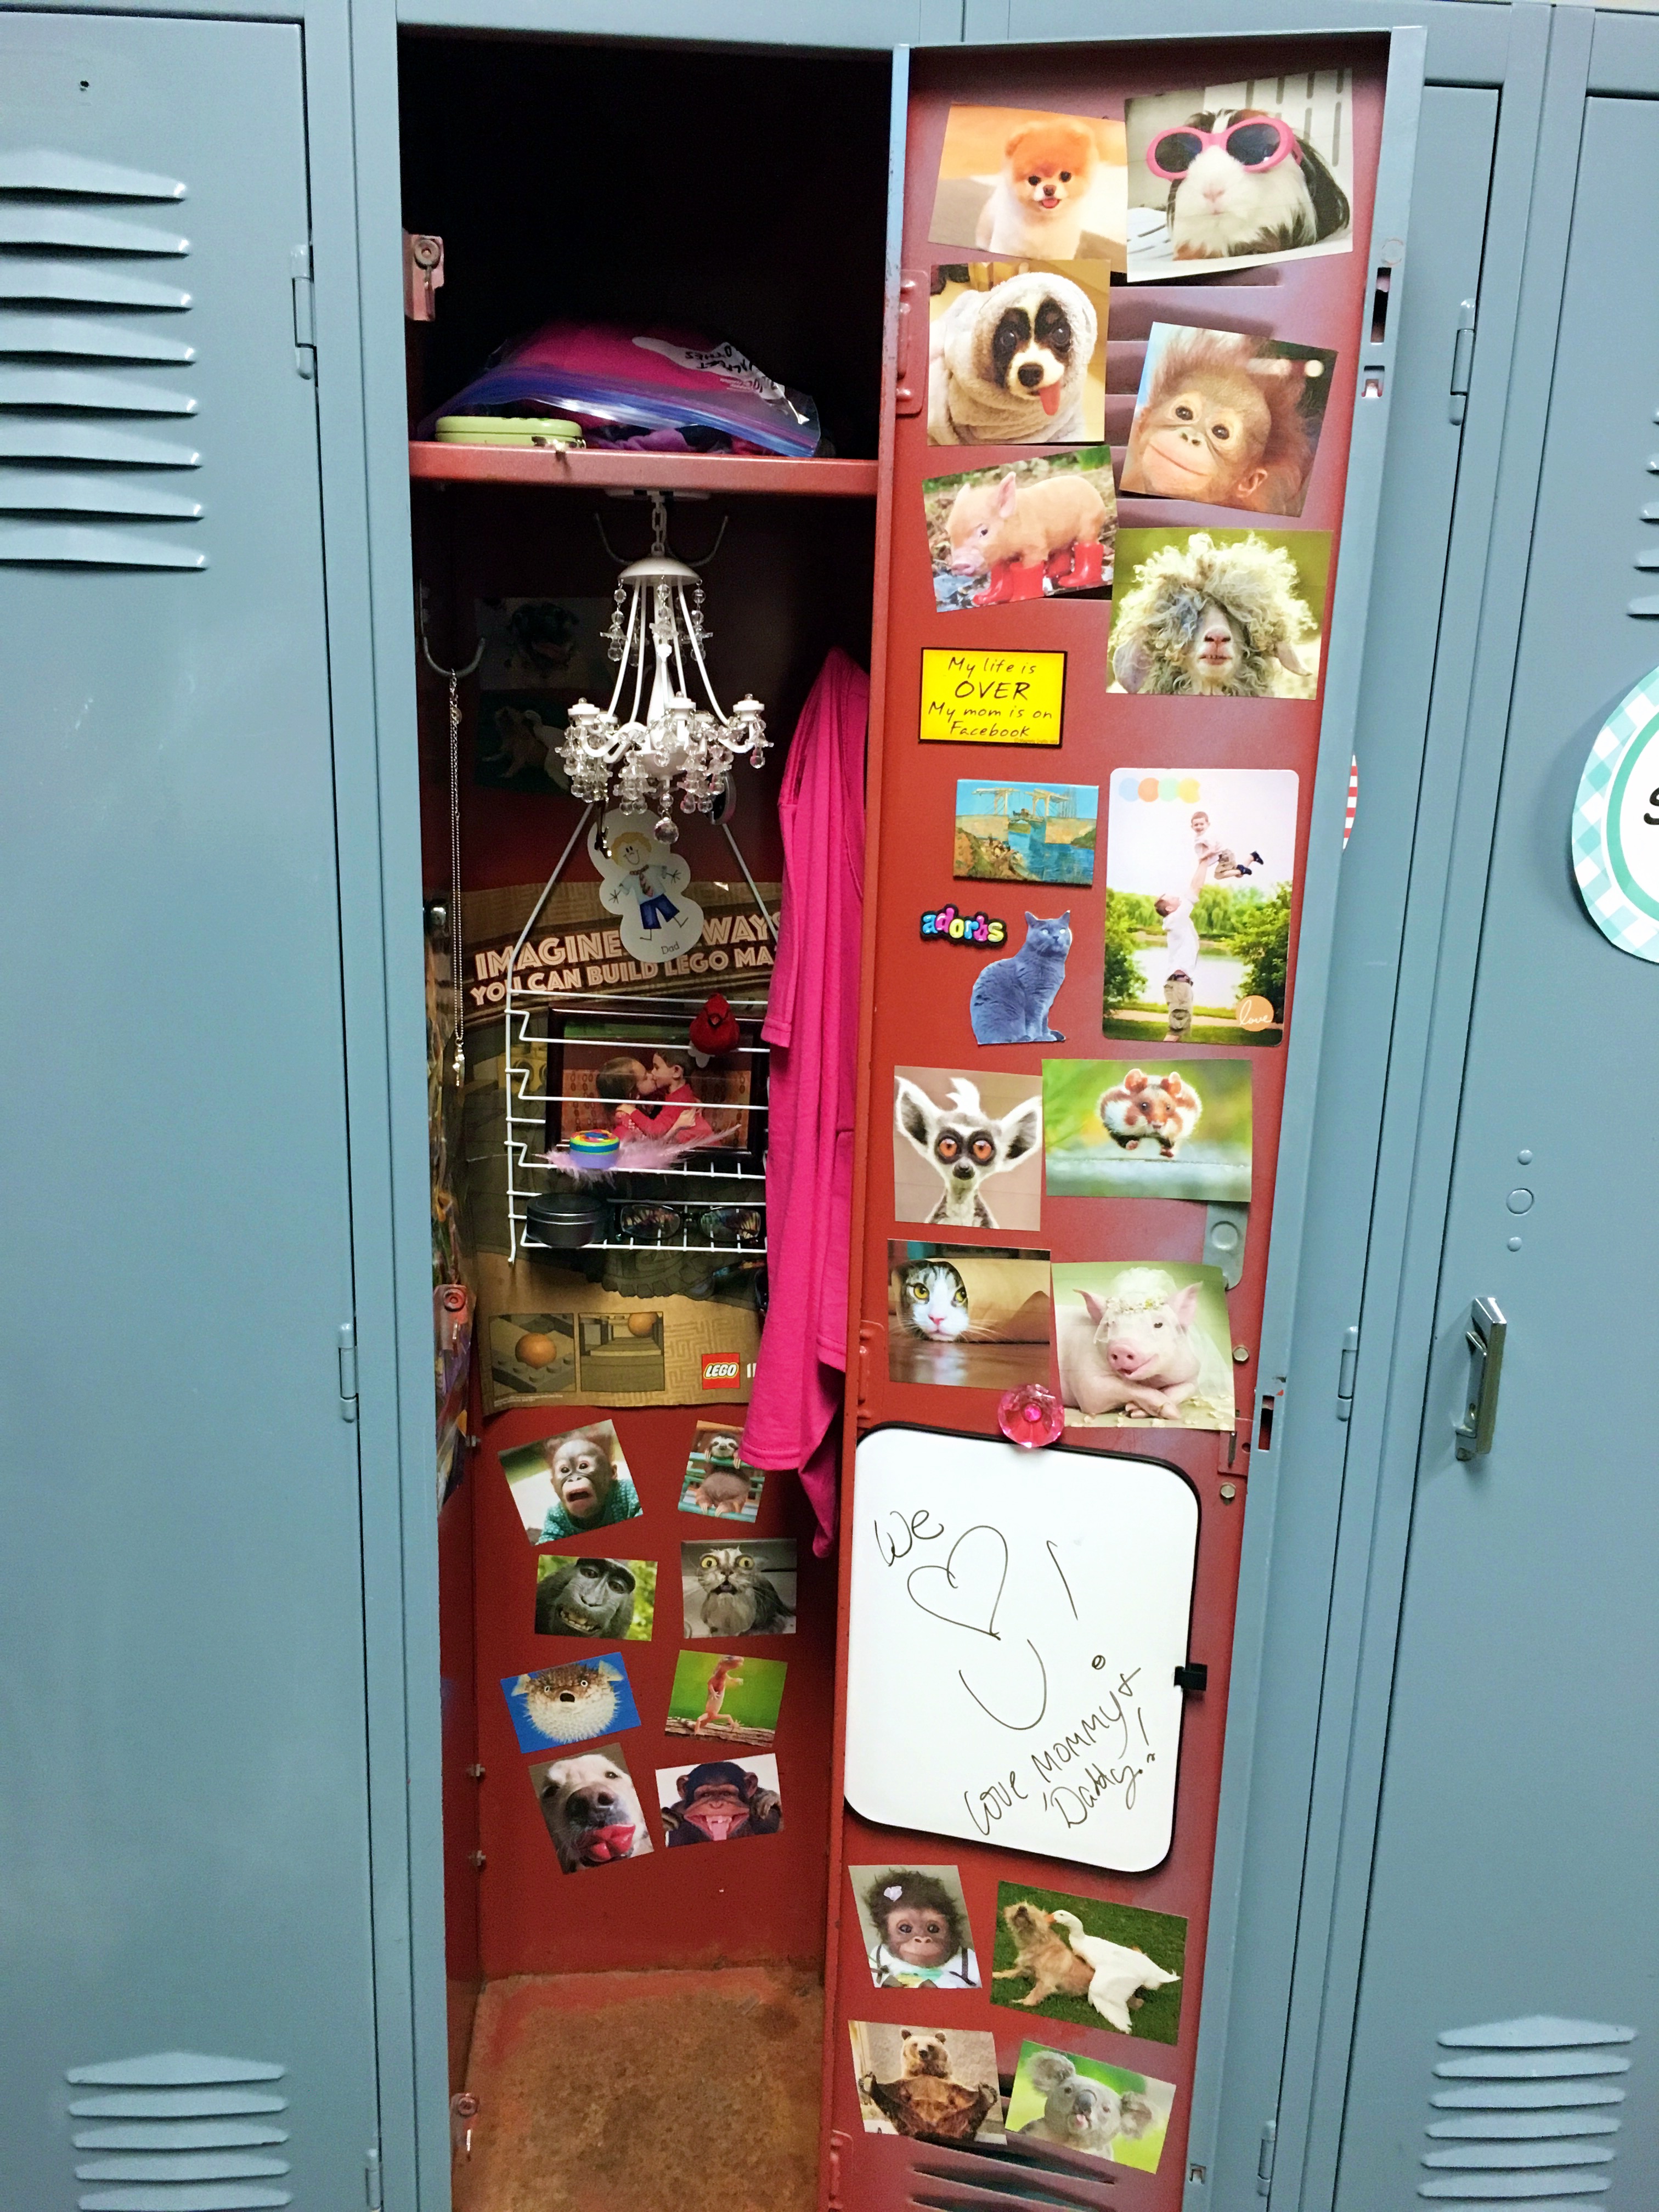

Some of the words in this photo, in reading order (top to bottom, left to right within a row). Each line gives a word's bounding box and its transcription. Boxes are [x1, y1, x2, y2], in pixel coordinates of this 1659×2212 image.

[948, 657, 975, 679] My
[984, 657, 1014, 673] life
[1021, 662, 1036, 674] is
[955, 680, 1030, 701] OVER
[928, 701, 956, 723] My
[963, 708, 1001, 716] mom
[1009, 705, 1024, 718] is
[1032, 710, 1052, 719] on
[950, 720, 1030, 737] Facebook
[922, 906, 1005, 943] adorbs
[475, 930, 622, 981] IMAGINE
[661, 941, 680, 955] Dad
[527, 968, 582, 992] CAN
[586, 961, 658, 986] BUILD
[664, 950, 729, 977] LEGO
[734, 946, 777, 968] MA
[1239, 999, 1272, 1026] love
[704, 1363, 738, 1379] LEGO
[874, 1509, 945, 1567] We
